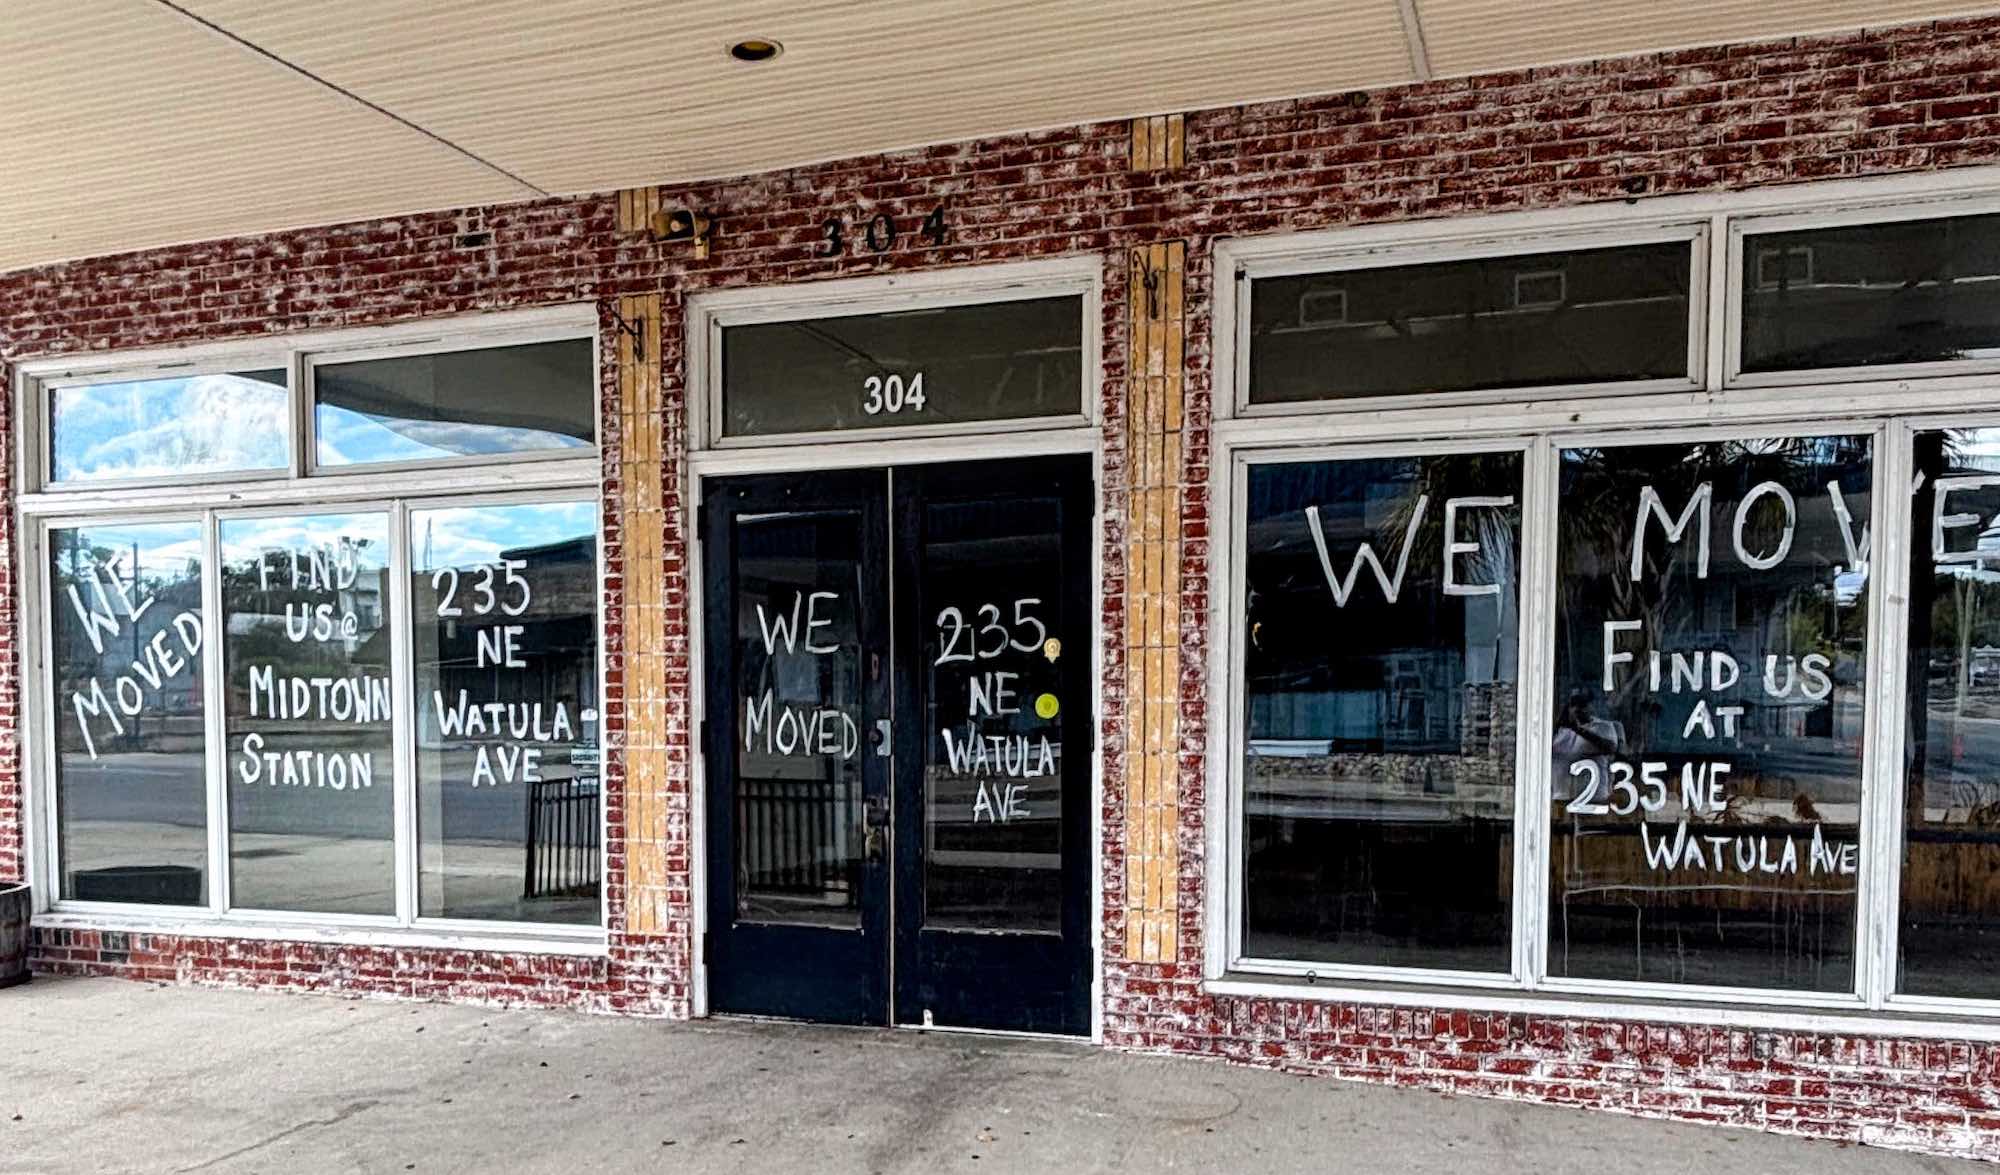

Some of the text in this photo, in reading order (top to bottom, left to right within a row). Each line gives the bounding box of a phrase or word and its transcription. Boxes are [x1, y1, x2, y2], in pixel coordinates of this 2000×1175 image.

[821, 208, 947, 257] 304
[863, 372, 926, 414] 304
[258, 540, 358, 591] FIND
[1304, 494, 1514, 607] WE
[67, 550, 154, 654] WE
[432, 559, 531, 617] 235
[286, 602, 333, 642] US
[477, 625, 527, 668] NE
[757, 590, 840, 655] WE
[934, 598, 1046, 666] 235
[72, 611, 202, 760] MOVED
[1602, 619, 1832, 700] FIND US
[249, 665, 391, 723] MIDTOWN
[434, 689, 574, 741] WATULA
[969, 671, 1021, 716] NE
[1682, 700, 1744, 739] AT
[746, 688, 858, 760] MOVED
[942, 720, 1055, 778] WATULA
[239, 732, 372, 790] STATION
[472, 747, 543, 787] AVE
[1566, 758, 1731, 815] 235 NE
[973, 780, 1031, 824] AVE
[1641, 819, 1858, 877] WATULA AVE
